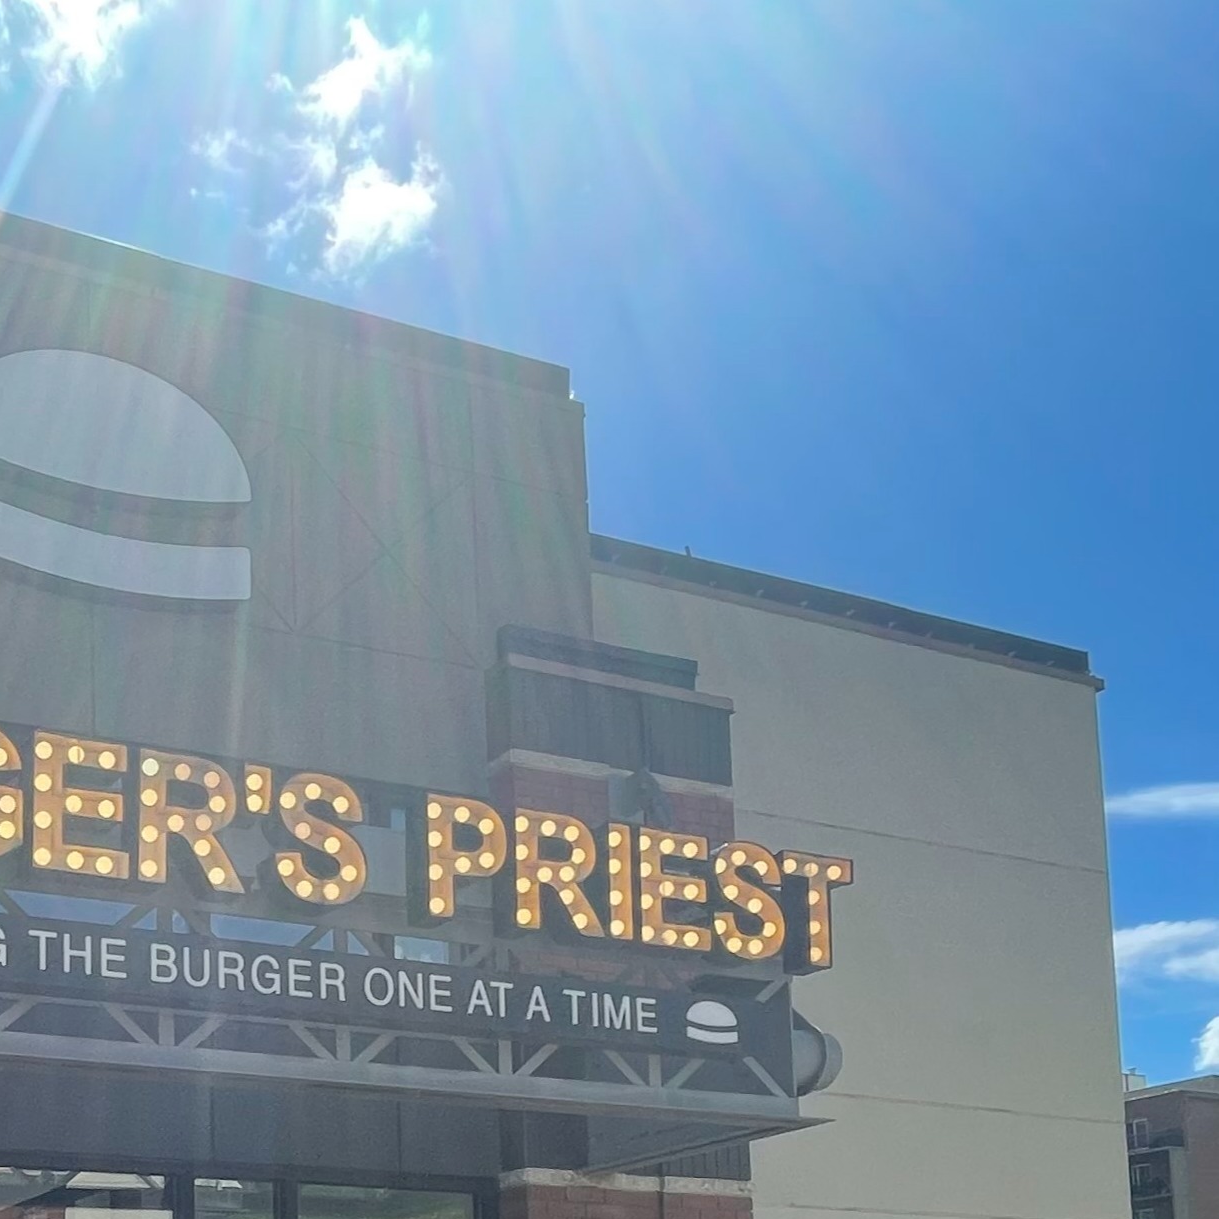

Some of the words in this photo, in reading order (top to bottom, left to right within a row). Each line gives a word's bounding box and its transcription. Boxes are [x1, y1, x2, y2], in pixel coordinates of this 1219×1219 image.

[426, 794, 853, 969] PRIEST
[28, 929, 128, 979] THE
[149, 944, 347, 1002] BURGER
[363, 967, 453, 1013] ONE
[468, 979, 515, 1018] AT
[526, 986, 551, 1023] A
[562, 989, 659, 1034] TIME
